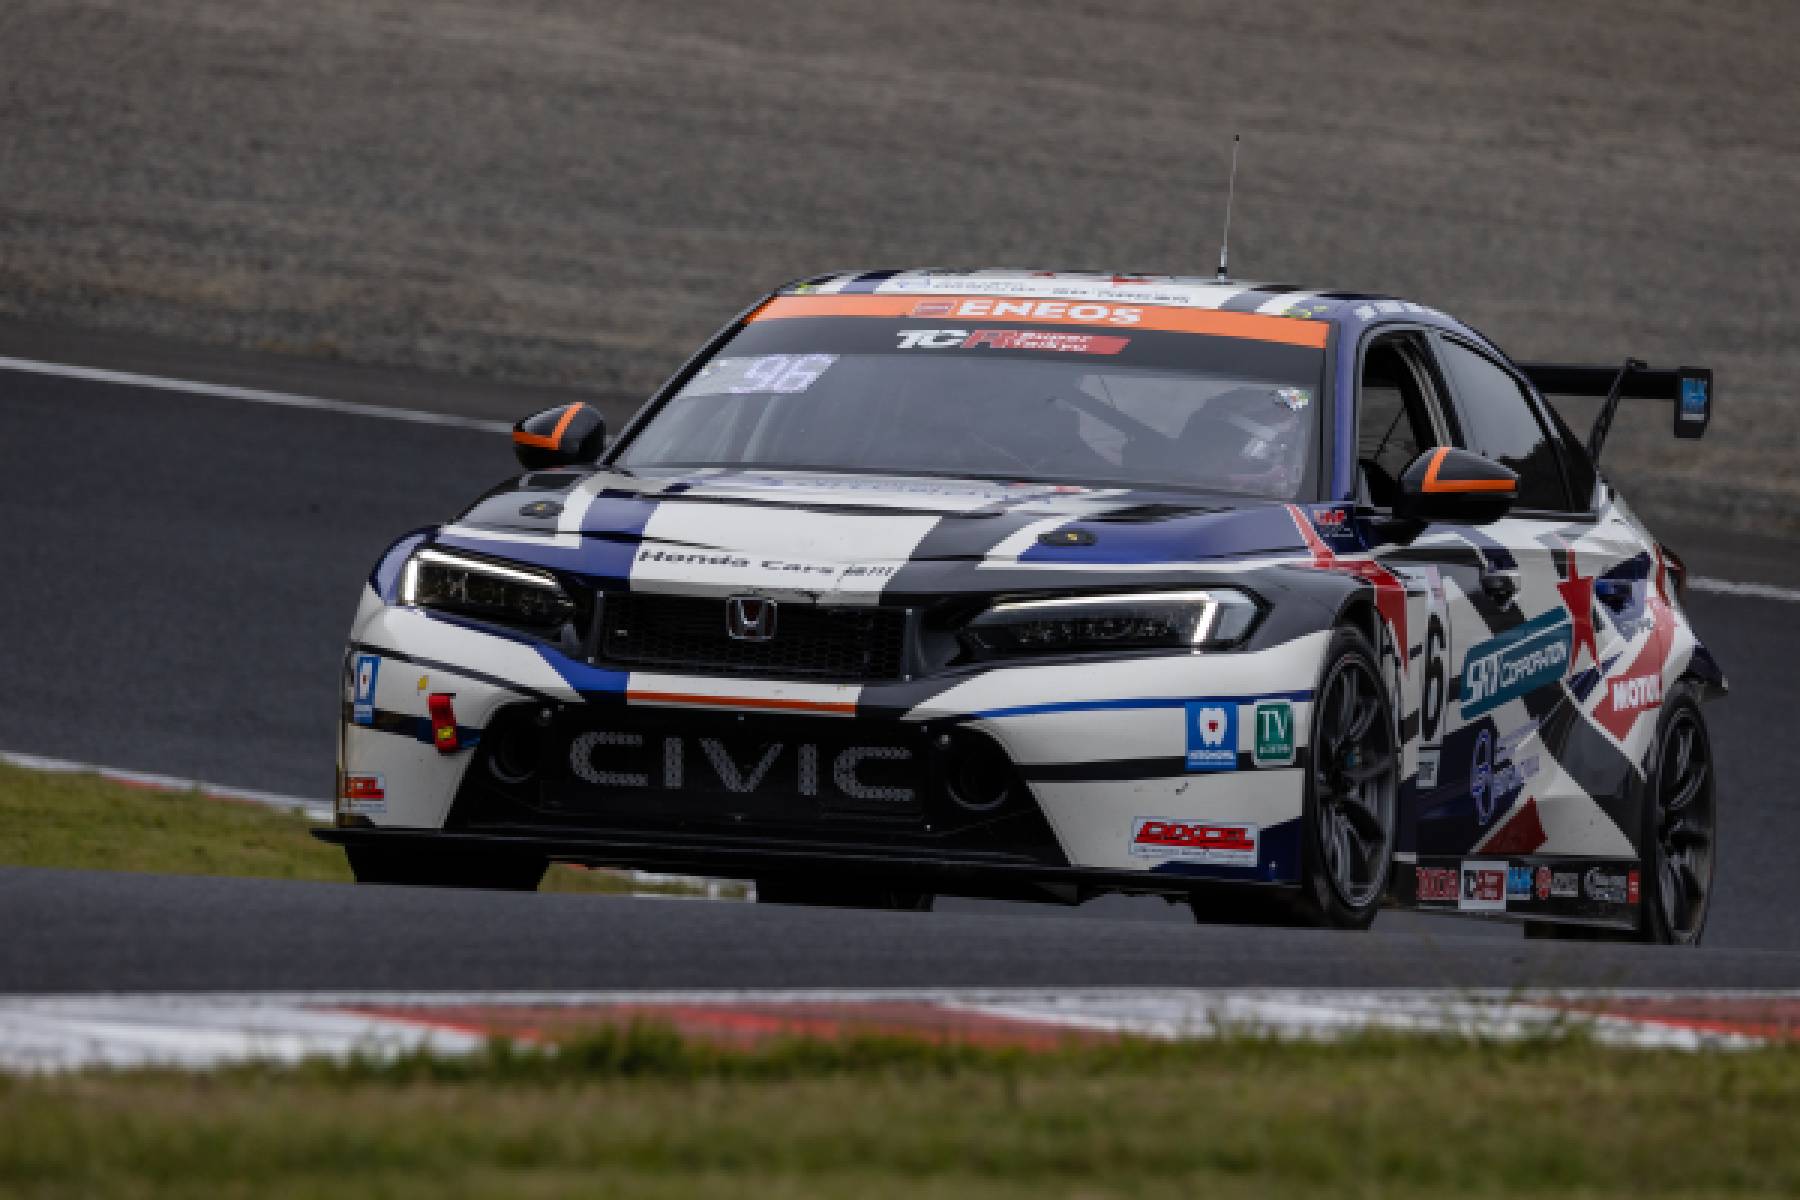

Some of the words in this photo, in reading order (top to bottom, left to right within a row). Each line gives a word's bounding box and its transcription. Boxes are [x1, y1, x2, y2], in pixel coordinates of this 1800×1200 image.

[956, 299, 1143, 325] ENEOS
[729, 354, 833, 394] 96
[638, 550, 750, 568] Honda
[761, 560, 834, 576] Cars
[1612, 674, 1661, 712] MOTUL
[1259, 710, 1292, 742] TV
[569, 731, 916, 803] CIVIC
